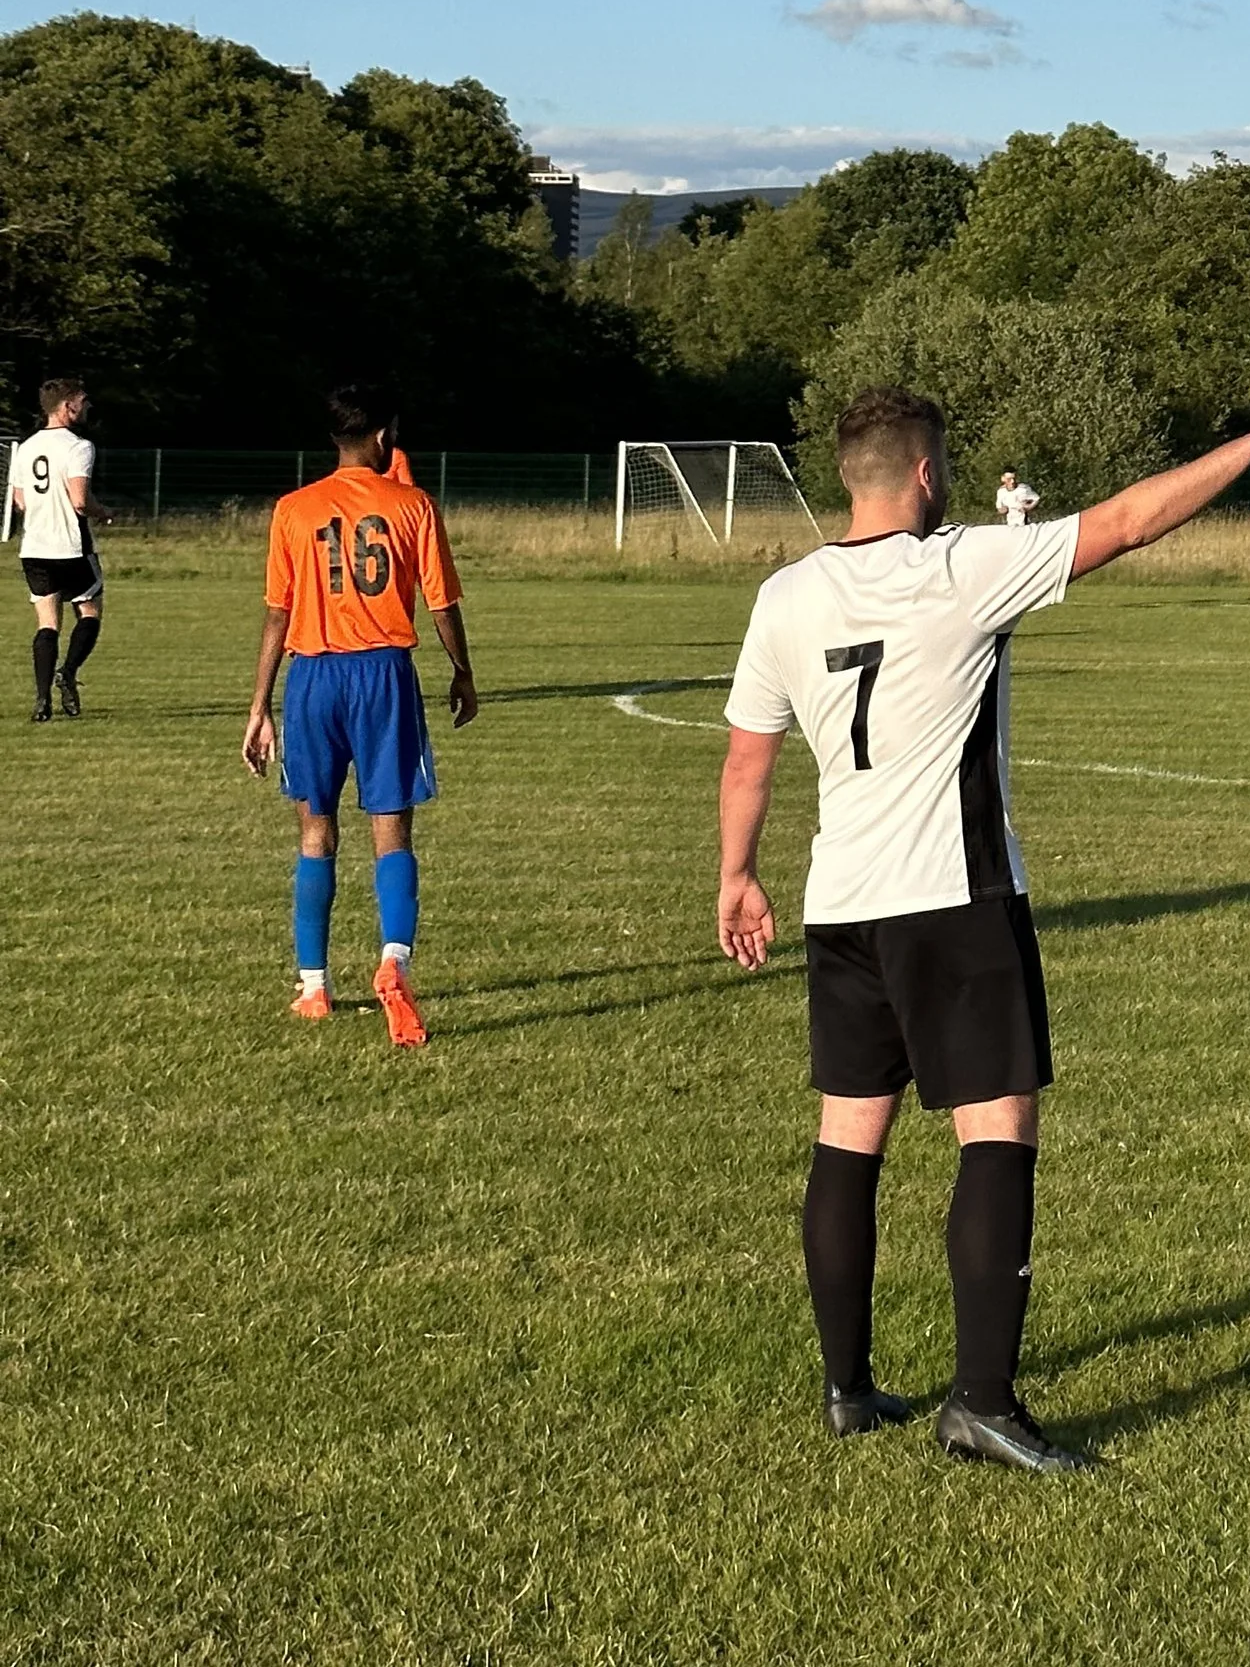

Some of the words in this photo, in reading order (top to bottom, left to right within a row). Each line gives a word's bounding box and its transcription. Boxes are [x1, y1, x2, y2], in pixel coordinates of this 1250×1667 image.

[32, 455, 50, 494] 9
[316, 515, 390, 596] 16
[824, 639, 885, 770] 7
